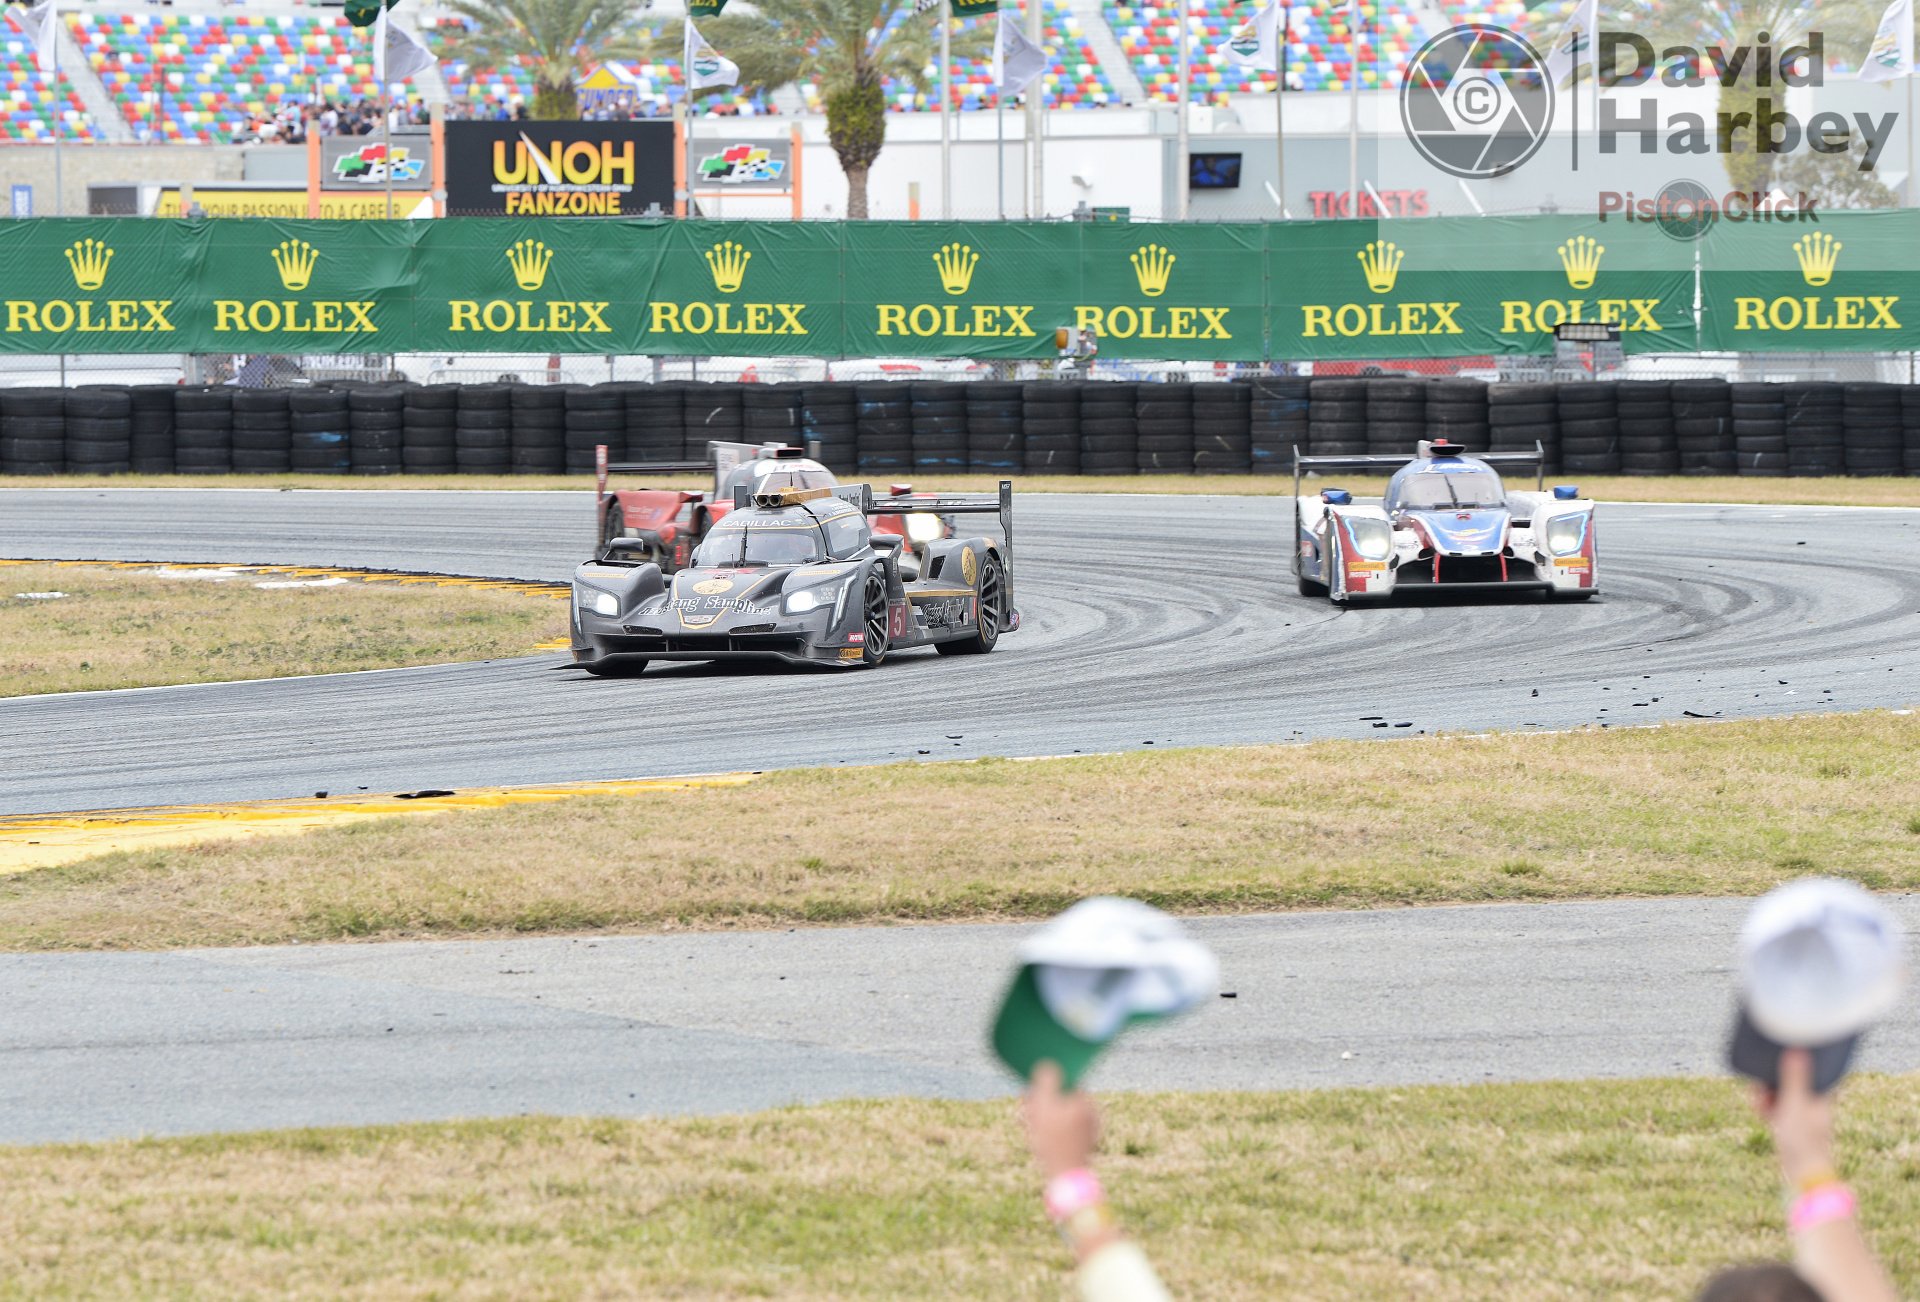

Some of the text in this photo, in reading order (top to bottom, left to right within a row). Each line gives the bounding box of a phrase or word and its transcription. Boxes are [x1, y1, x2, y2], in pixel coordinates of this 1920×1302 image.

[493, 136, 635, 185] UNOH
[243, 203, 298, 218] PASSION
[350, 203, 401, 219] CARER
[505, 192, 622, 215] FANZONE
[6, 300, 175, 333] ROLEX
[215, 300, 378, 333] ROLEX
[449, 300, 611, 333] ROLEX
[649, 302, 808, 335] ROLEX
[876, 304, 1036, 337] ROLEX
[1074, 306, 1232, 339] ROLEX
[1302, 302, 1463, 337] ROLEX
[1736, 296, 1902, 331] ROLEX
[722, 518, 792, 527] CADILLAC
[893, 608, 902, 637] 5
